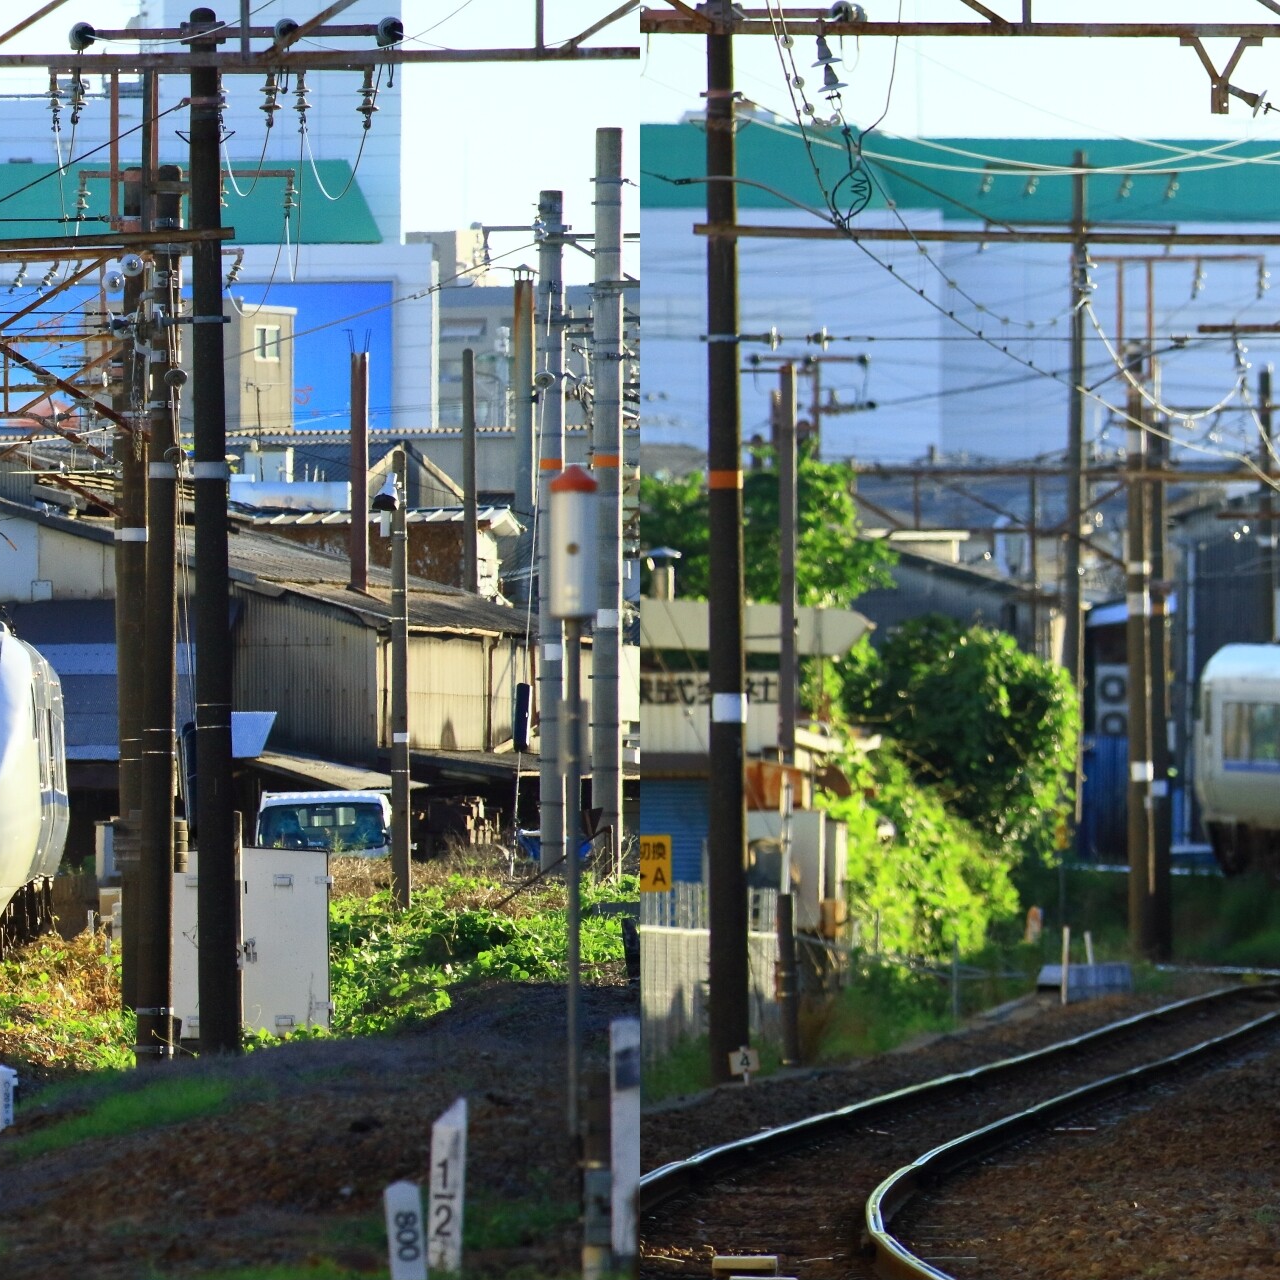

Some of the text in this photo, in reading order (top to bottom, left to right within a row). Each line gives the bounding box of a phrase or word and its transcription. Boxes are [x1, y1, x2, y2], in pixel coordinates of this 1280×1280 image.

[652, 866, 666, 886] A
[740, 1054, 751, 1067] 4
[394, 1210, 420, 1262] 800
